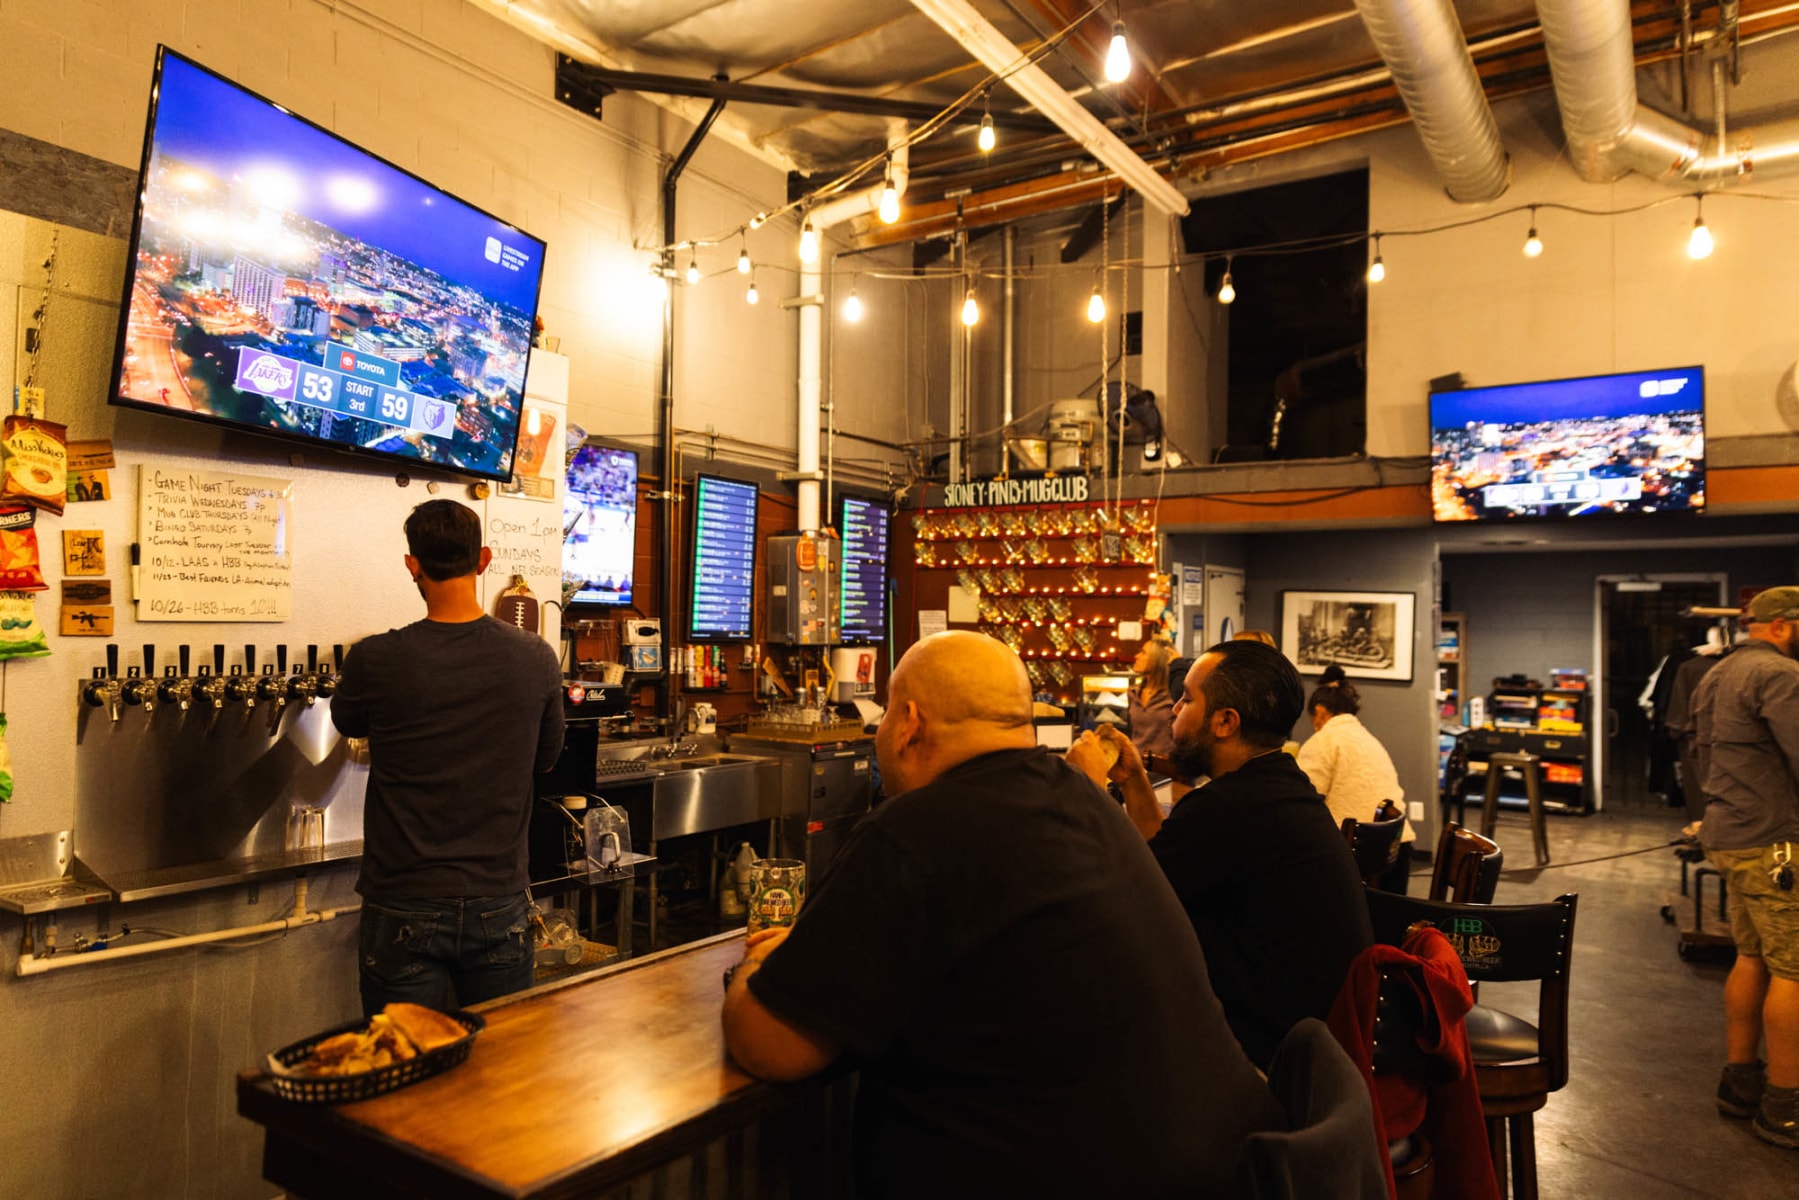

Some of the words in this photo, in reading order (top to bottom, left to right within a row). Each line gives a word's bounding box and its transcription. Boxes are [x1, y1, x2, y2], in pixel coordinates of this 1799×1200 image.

[356, 360, 386, 377] TOYOTA
[302, 371, 333, 403] 53
[345, 380, 375, 398] START
[349, 398, 366, 412] 3rd
[381, 393, 409, 421] 59
[154, 470, 186, 492] GAME
[188, 474, 222, 493] NIGHT
[224, 479, 266, 498] TUESDAYS
[154, 491, 187, 504] TRIVIA
[190, 494, 248, 510] WEDNESDAYS
[944, 482, 986, 507] STONEY
[156, 506, 176, 518] MUG
[179, 508, 201, 519] CLUB
[202, 510, 248, 520] THURSDAYS
[188, 520, 238, 534] SATURDAYS
[490, 517, 527, 540] Open
[488, 563, 505, 576] ALL
[150, 599, 184, 616] 10/26
[97, 668, 102, 678] 1
[131, 667, 137, 677] 2
[168, 667, 174, 677] 3
[201, 666, 207, 676] 4
[233, 666, 239, 676] 5
[295, 665, 301, 674] 7
